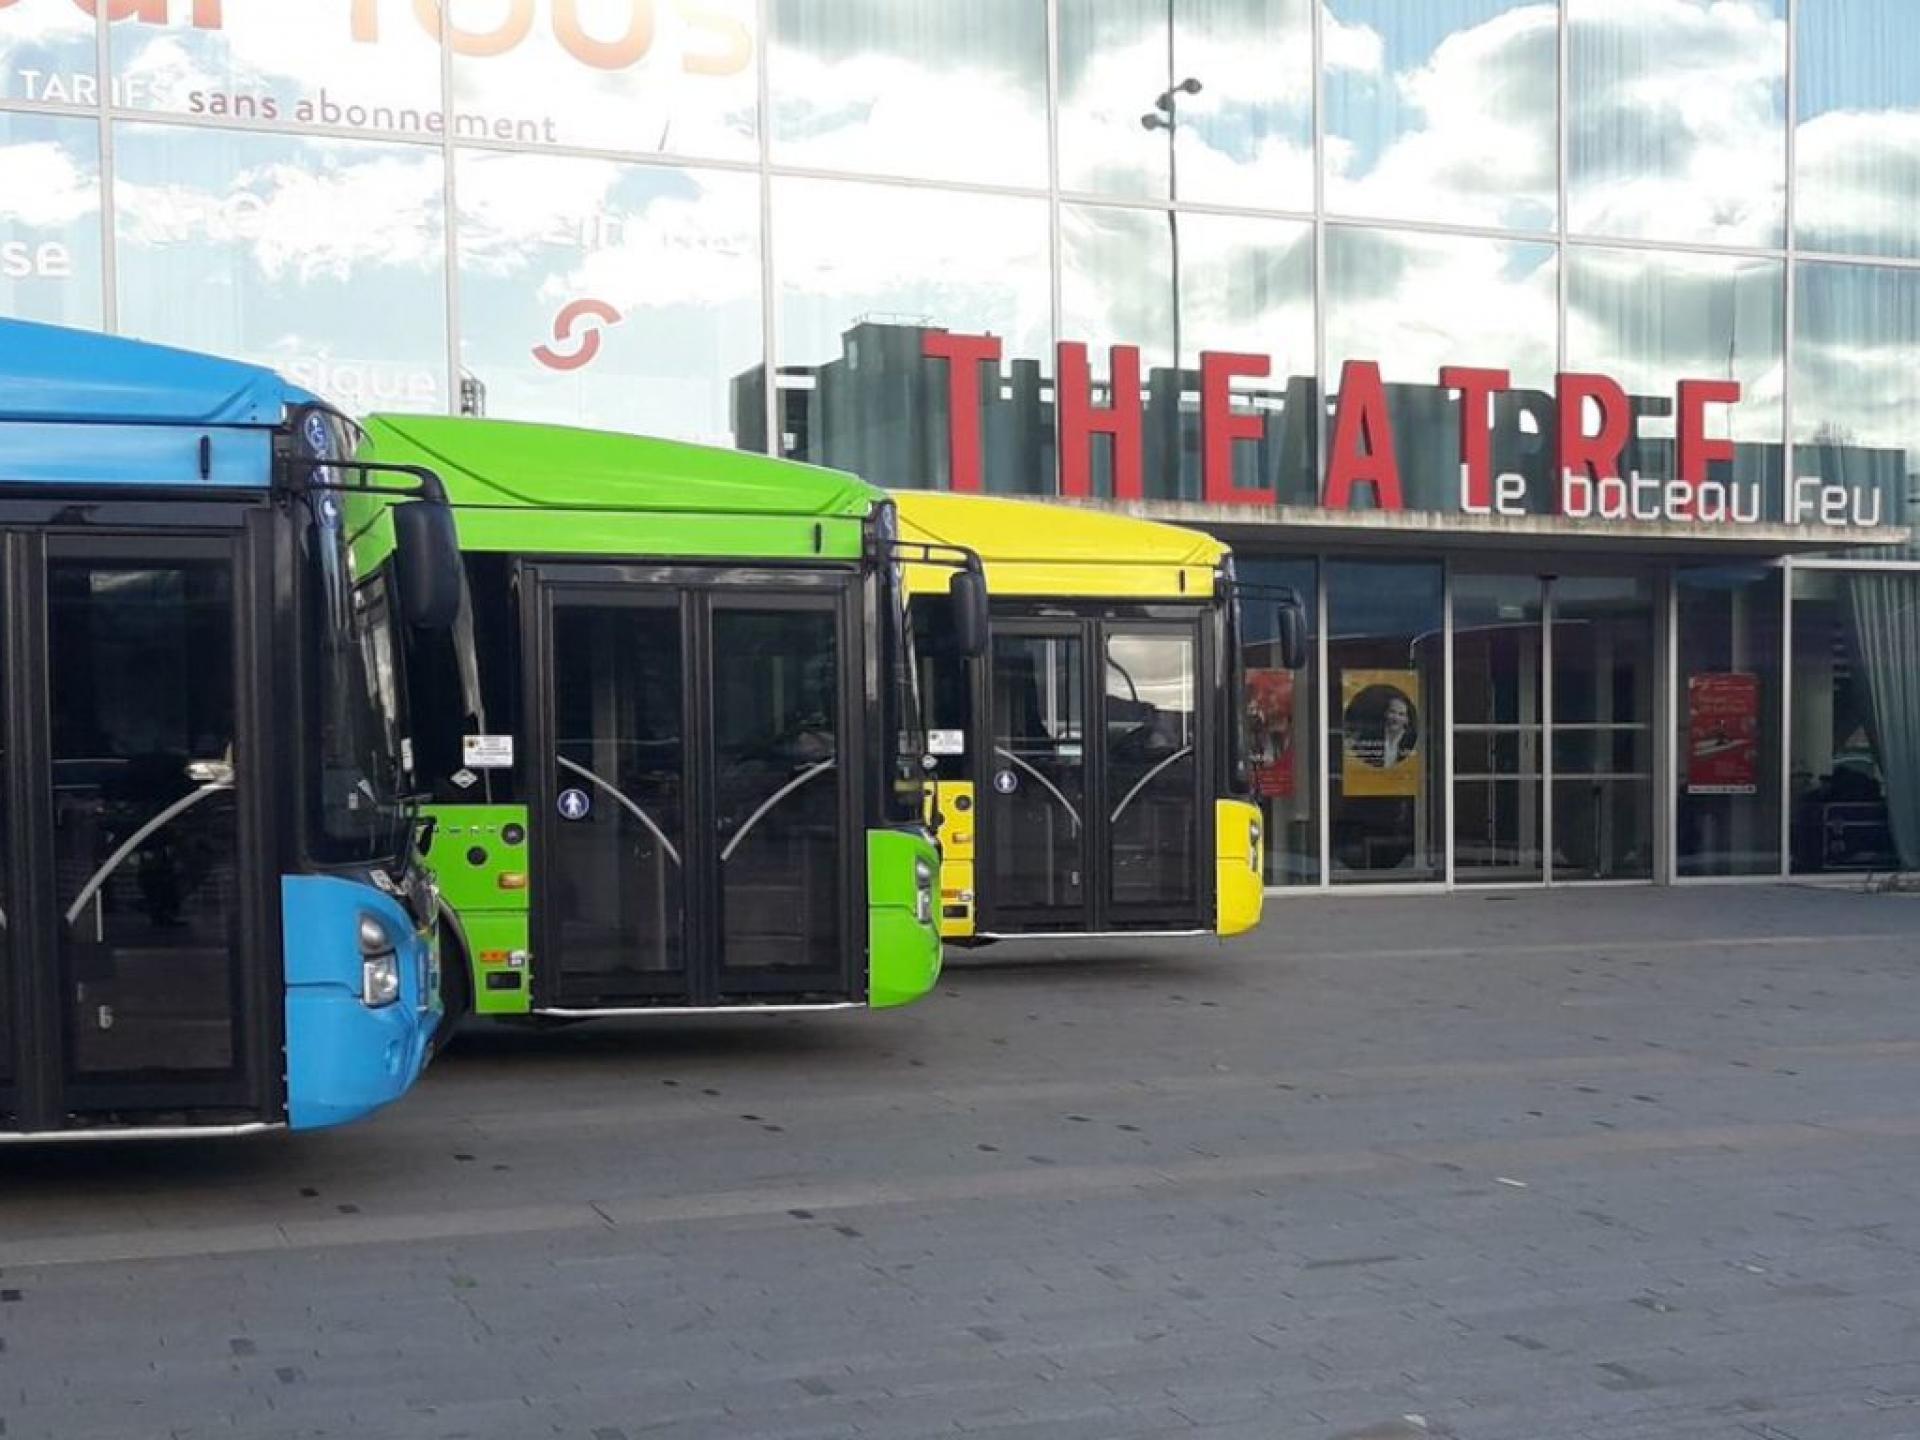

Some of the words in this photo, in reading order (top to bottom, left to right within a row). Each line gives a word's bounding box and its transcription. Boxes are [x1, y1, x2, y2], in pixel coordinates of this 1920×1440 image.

[189, 91, 278, 120] sans
[296, 88, 557, 143] abonnement
[921, 329, 1741, 519] THEATRE
[1460, 463, 1526, 515] Le
[1562, 466, 1760, 524] bateau
